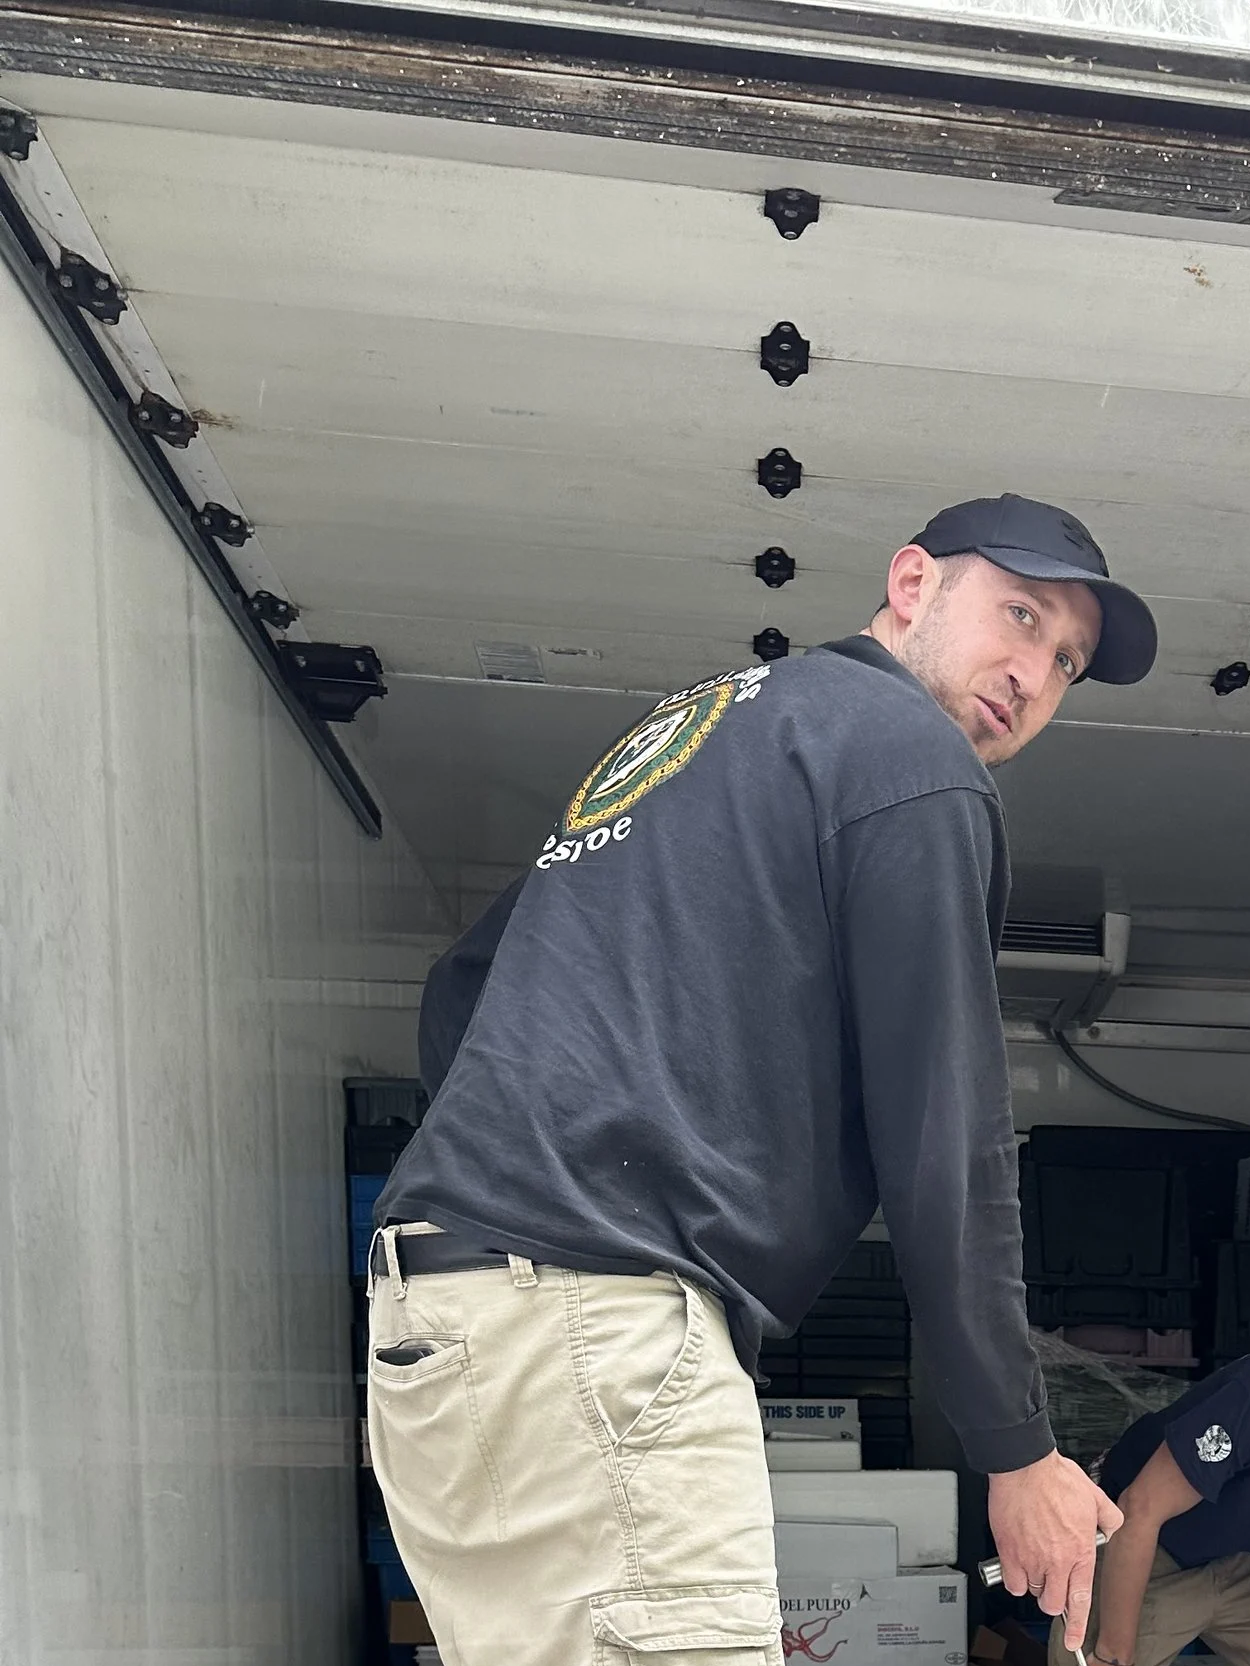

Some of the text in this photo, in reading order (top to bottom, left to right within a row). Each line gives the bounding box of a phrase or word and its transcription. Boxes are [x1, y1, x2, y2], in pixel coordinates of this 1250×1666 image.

[763, 1406, 846, 1418] THIS SIDE UP
[780, 1598, 851, 1611] DEL PULPO
